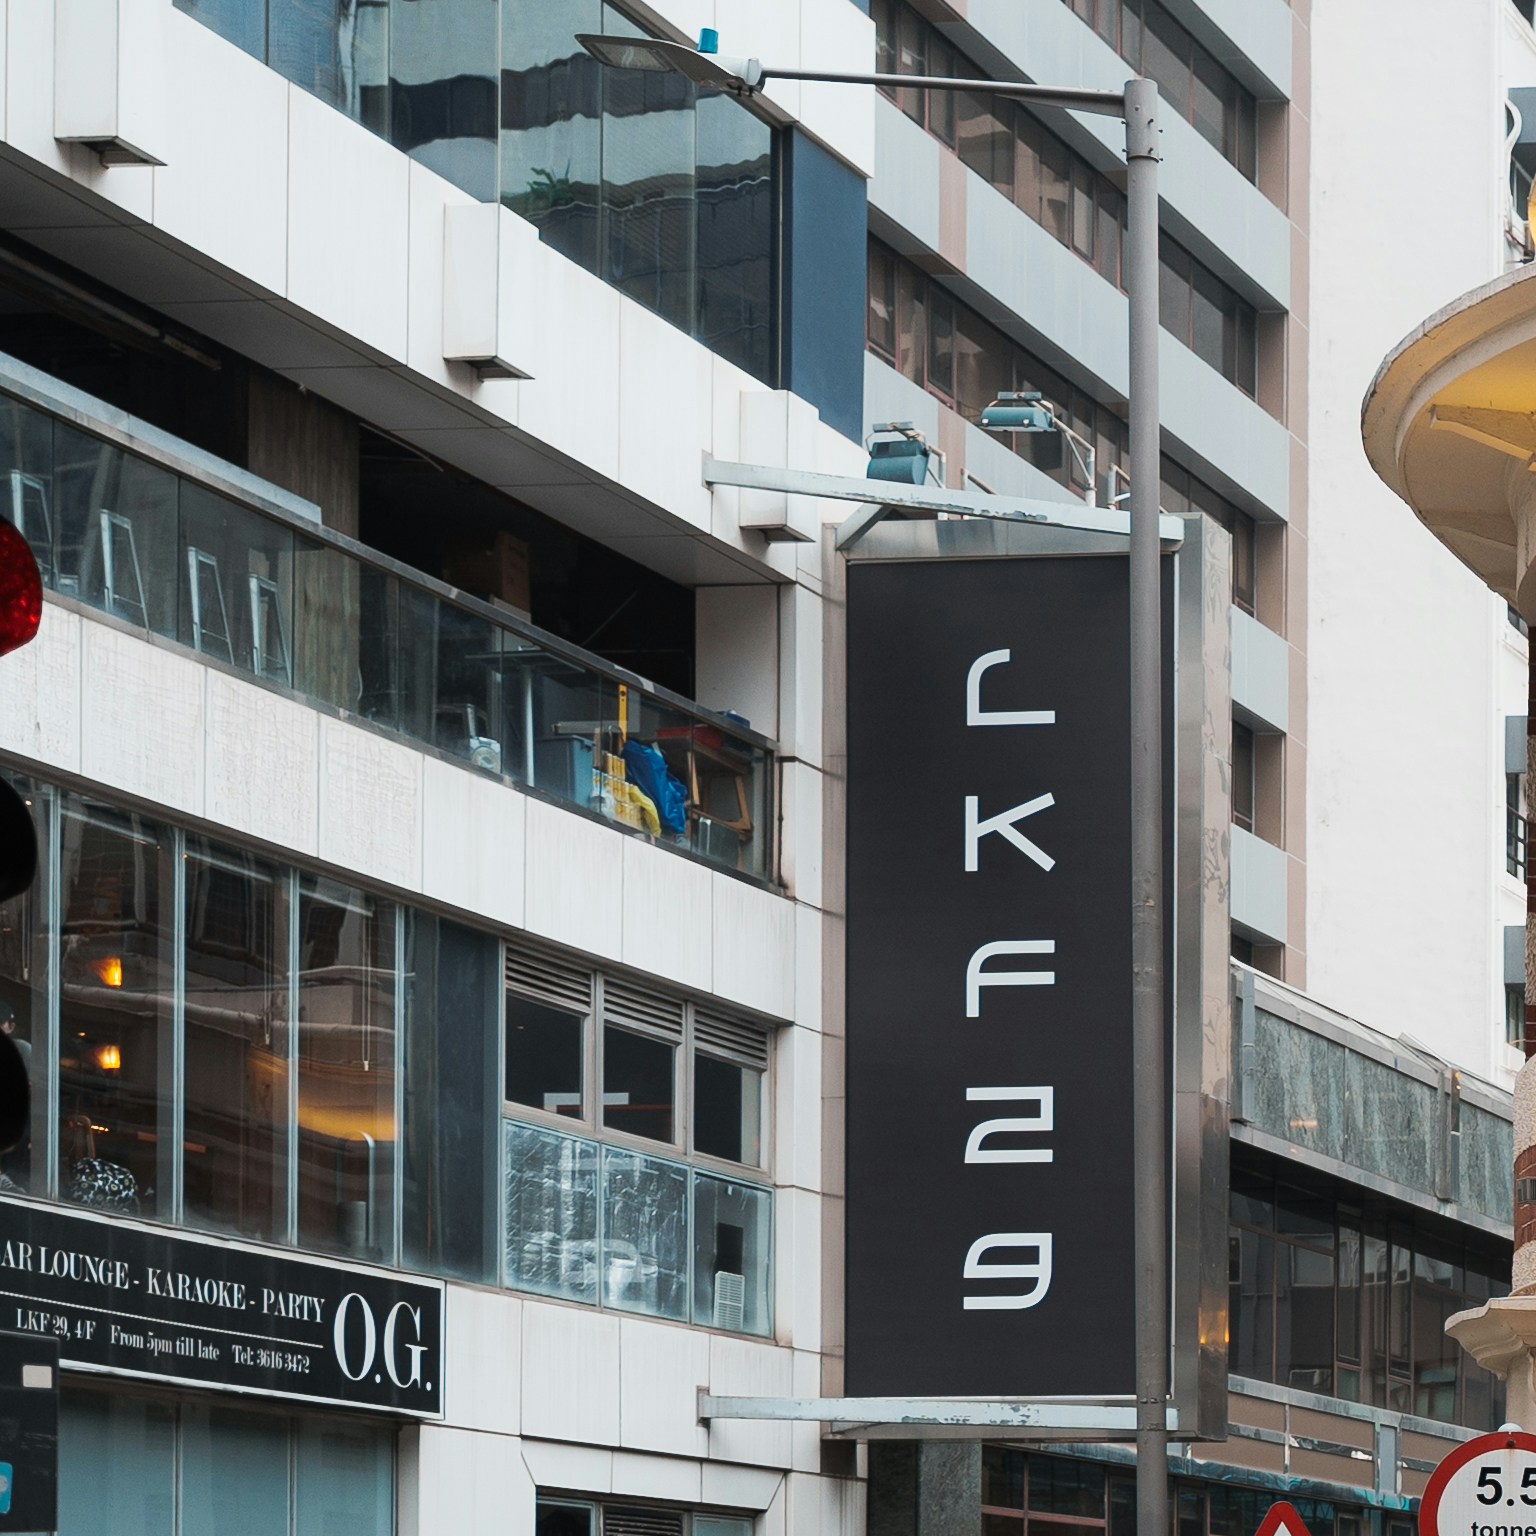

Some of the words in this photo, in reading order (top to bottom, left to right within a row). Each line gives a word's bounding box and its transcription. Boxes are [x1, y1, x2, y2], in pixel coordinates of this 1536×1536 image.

[38, 1246, 129, 1289] LOUNGE
[146, 1267, 246, 1310] KARAOKE
[261, 1288, 325, 1323] PARTY
[16, 1307, 50, 1332] LKF
[74, 1320, 96, 1340] 4/F
[110, 1325, 144, 1349] From
[147, 1332, 172, 1356] 5pm
[175, 1336, 194, 1357] till
[198, 1340, 220, 1361] late
[231, 1344, 254, 1366] Tel:
[256, 1351, 283, 1370] 3616
[285, 1355, 311, 1374] 3472
